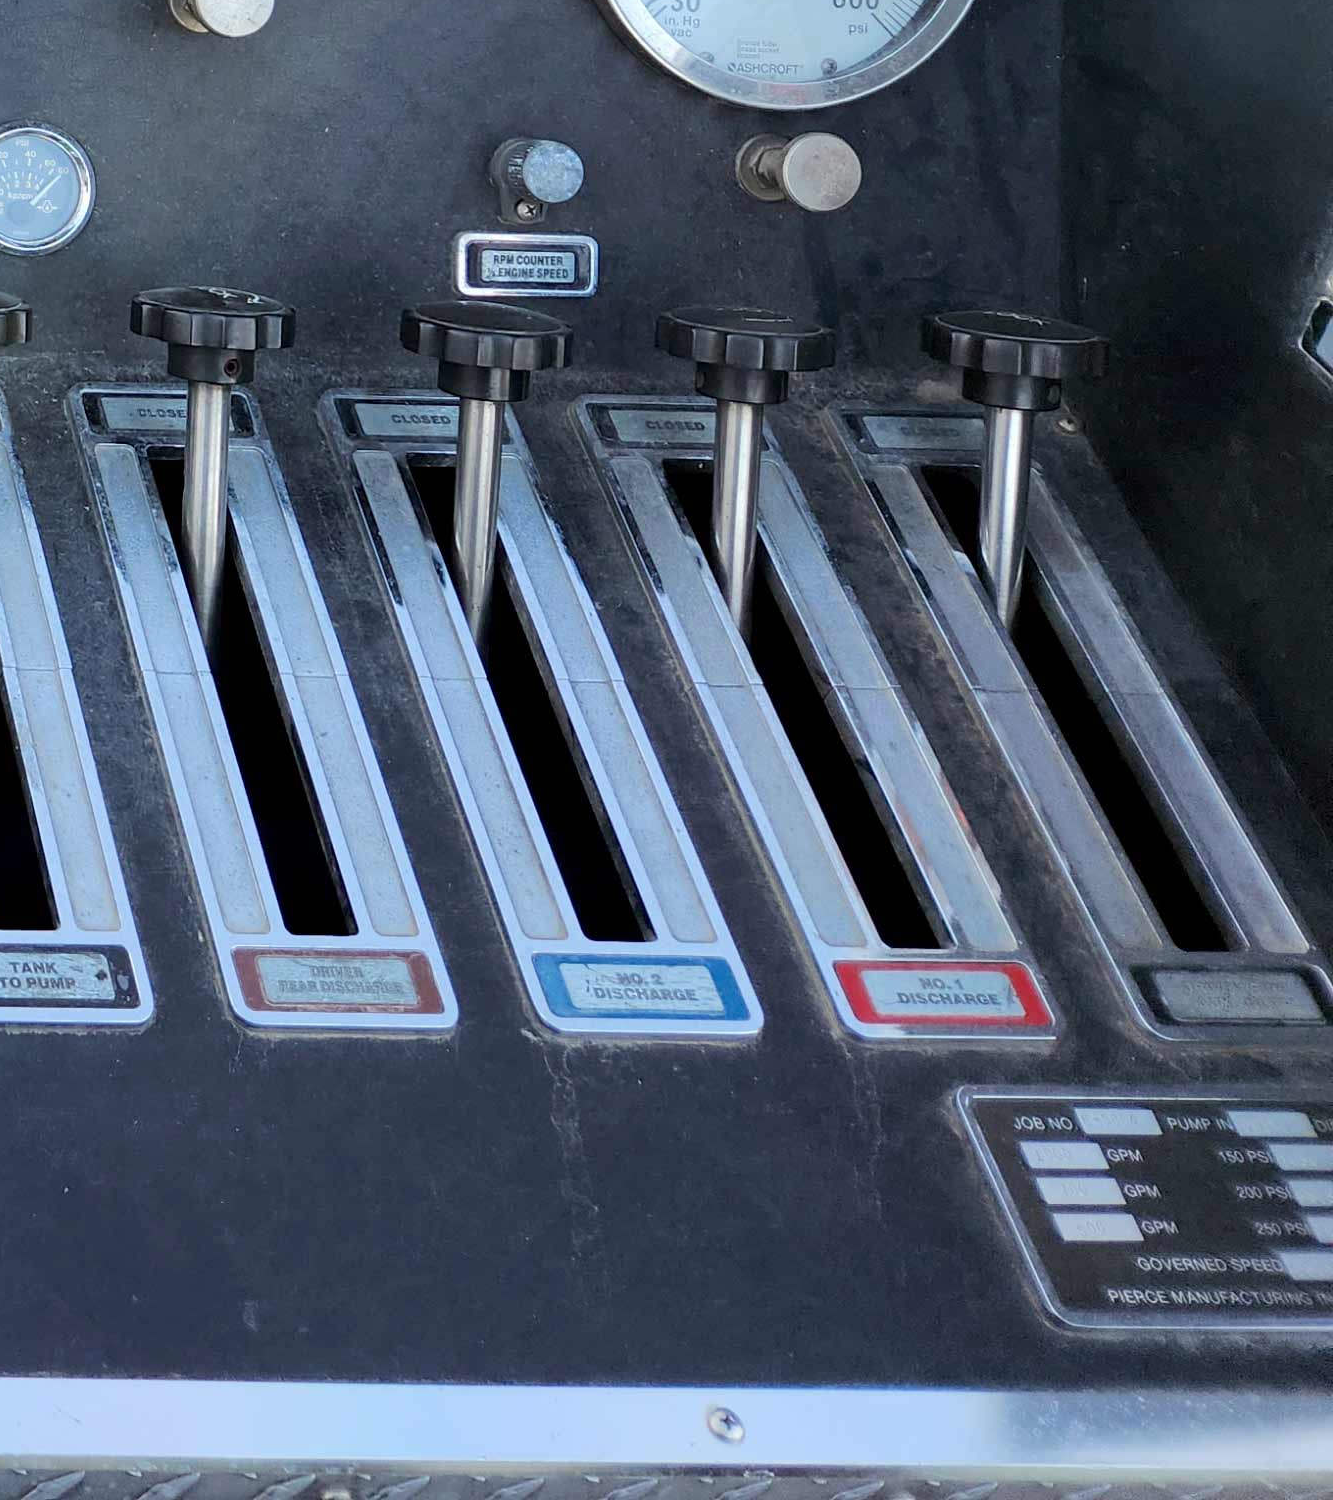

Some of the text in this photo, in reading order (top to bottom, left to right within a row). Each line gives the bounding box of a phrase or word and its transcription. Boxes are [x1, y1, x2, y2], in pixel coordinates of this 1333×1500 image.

[738, 64, 798, 74] ASHCROFT
[493, 255, 563, 265] RPM COUNTER
[498, 268, 568, 278] ENGINE SPEED
[9, 962, 58, 974] TANK
[26, 978, 76, 989] PUMP
[615, 973, 663, 985] NO. 2
[919, 978, 964, 990] NO. 1
[593, 987, 698, 1000] DISCHARGE
[897, 992, 1002, 1005] DISCHARGE
[1013, 1117, 1045, 1130] JOB
[1166, 1117, 1211, 1130] PUMP
[1106, 1149, 1144, 1162] GPM
[1123, 1185, 1161, 1198] GPM
[1141, 1221, 1179, 1234] GPM
[1137, 1258, 1282, 1272] GOVERNED SPEED
[1107, 1290, 1314, 1306] PIERCE MANUFACTURING
